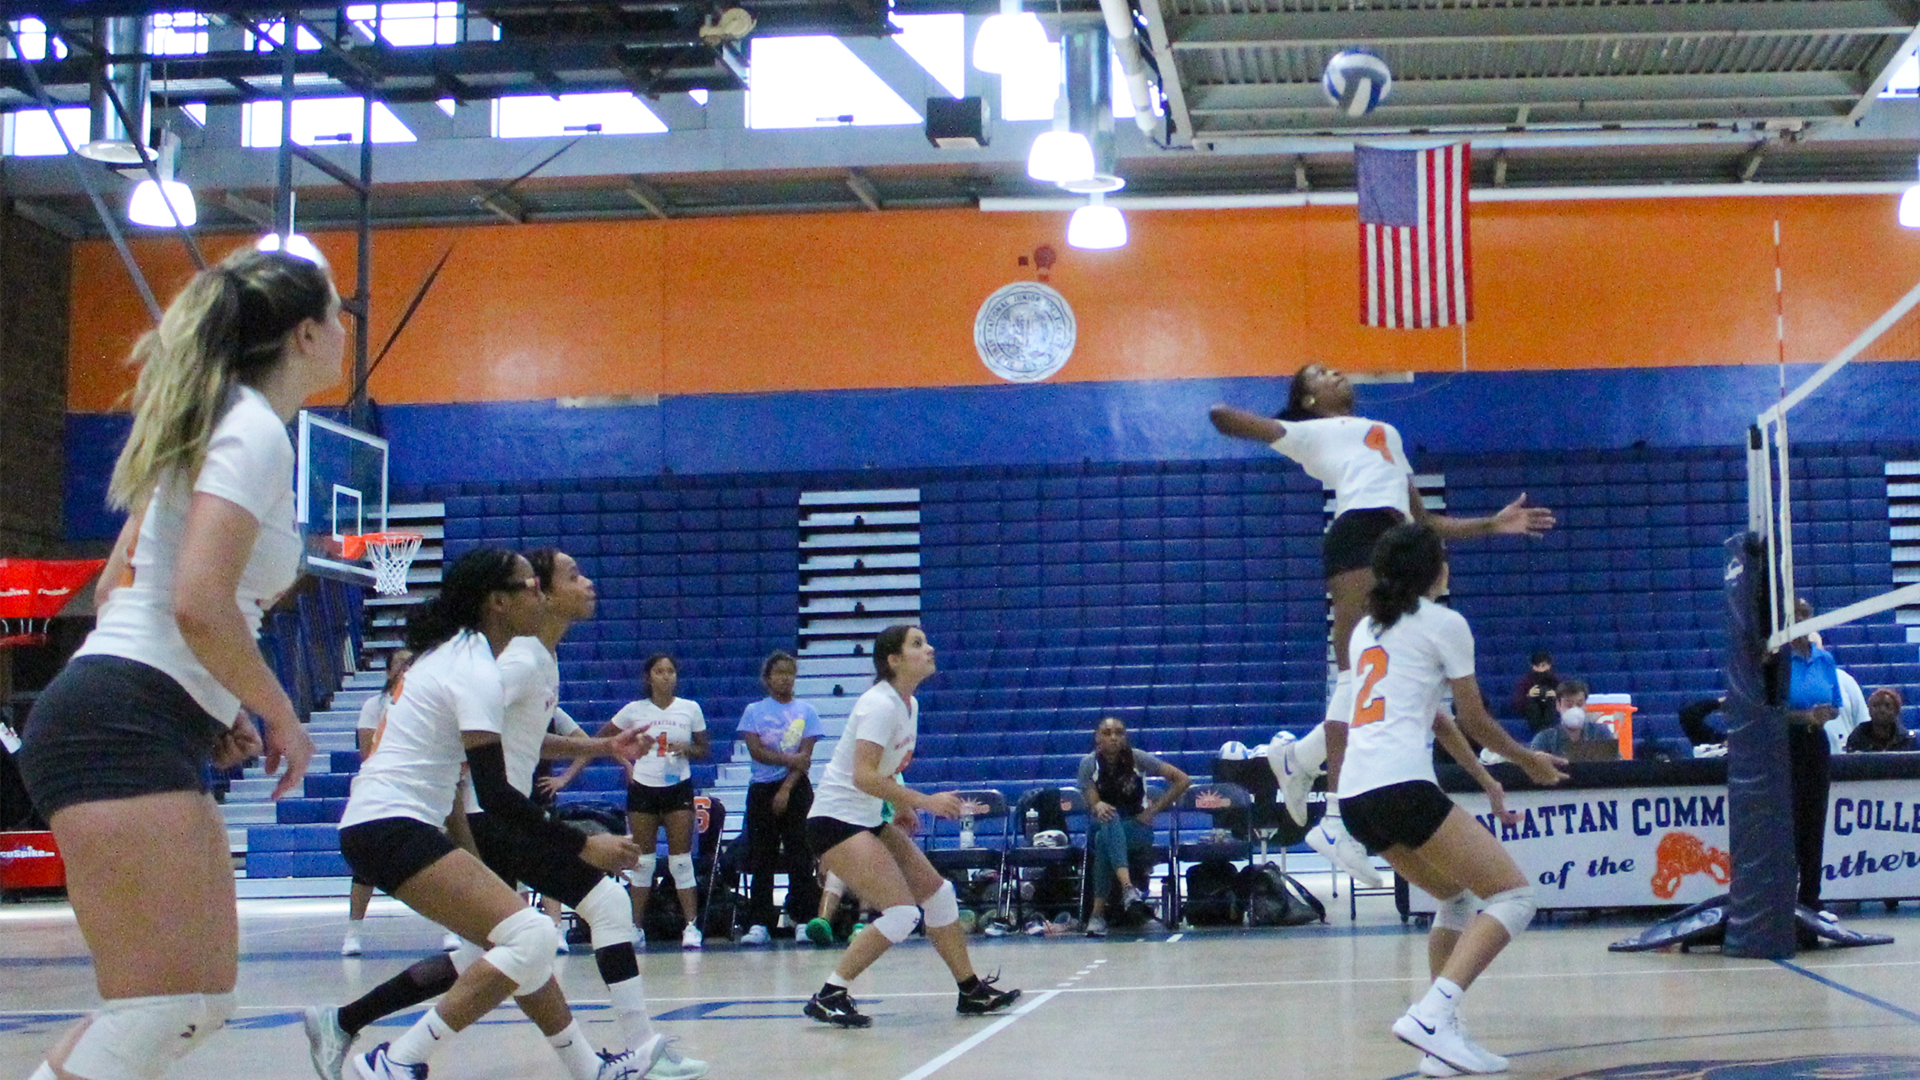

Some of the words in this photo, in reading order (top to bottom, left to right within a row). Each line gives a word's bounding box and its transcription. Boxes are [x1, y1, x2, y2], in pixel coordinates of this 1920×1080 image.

[1013, 294, 1041, 303] JUNIOR
[1350, 645, 1389, 727] 2
[655, 731, 668, 757] 1
[1476, 800, 1618, 842] NHATTAN
[1631, 796, 1726, 836] COMM
[1834, 797, 1920, 836] COLLE
[1539, 860, 1575, 889] of
[1587, 856, 1635, 878] the
[1820, 850, 1920, 881] nther
